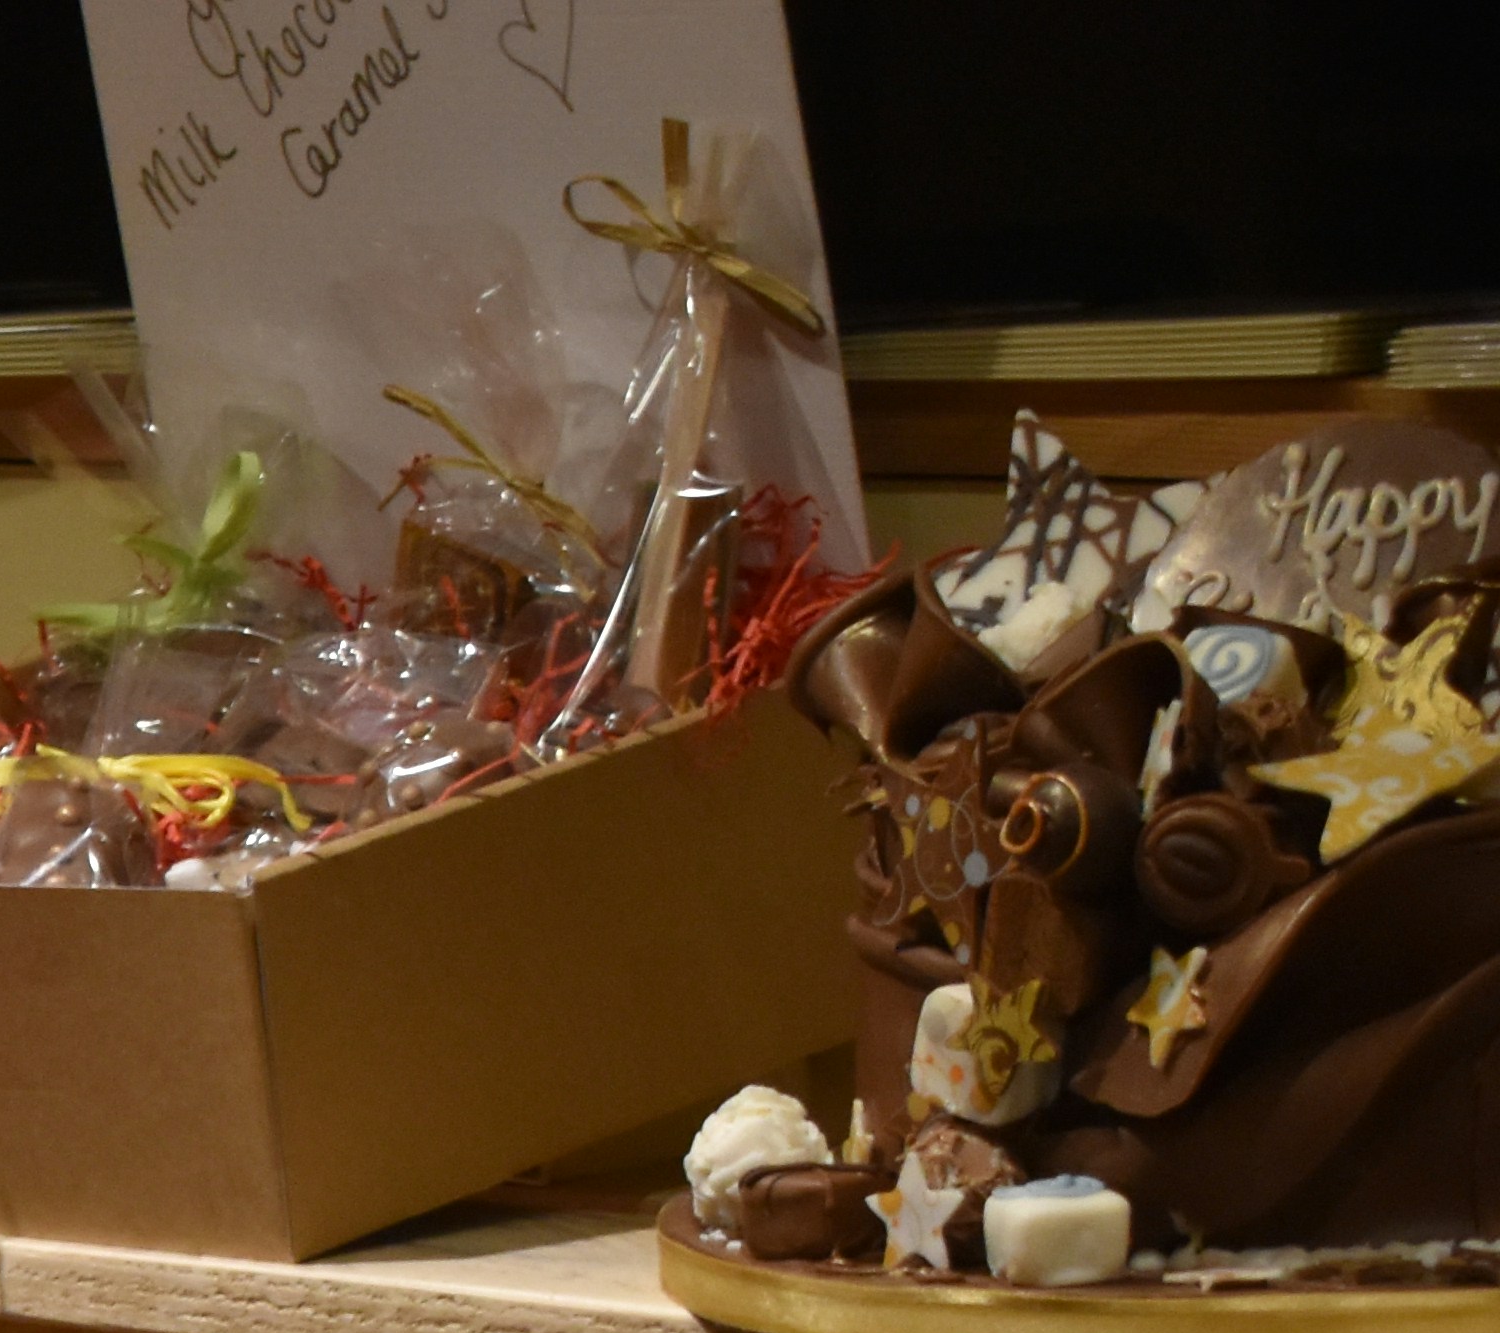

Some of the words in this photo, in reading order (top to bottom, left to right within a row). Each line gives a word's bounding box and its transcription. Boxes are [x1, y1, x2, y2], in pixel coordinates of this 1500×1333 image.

[139, 112, 237, 230] Milk
[281, 6, 420, 198] Caramel
[1257, 443, 1500, 584] Happy
